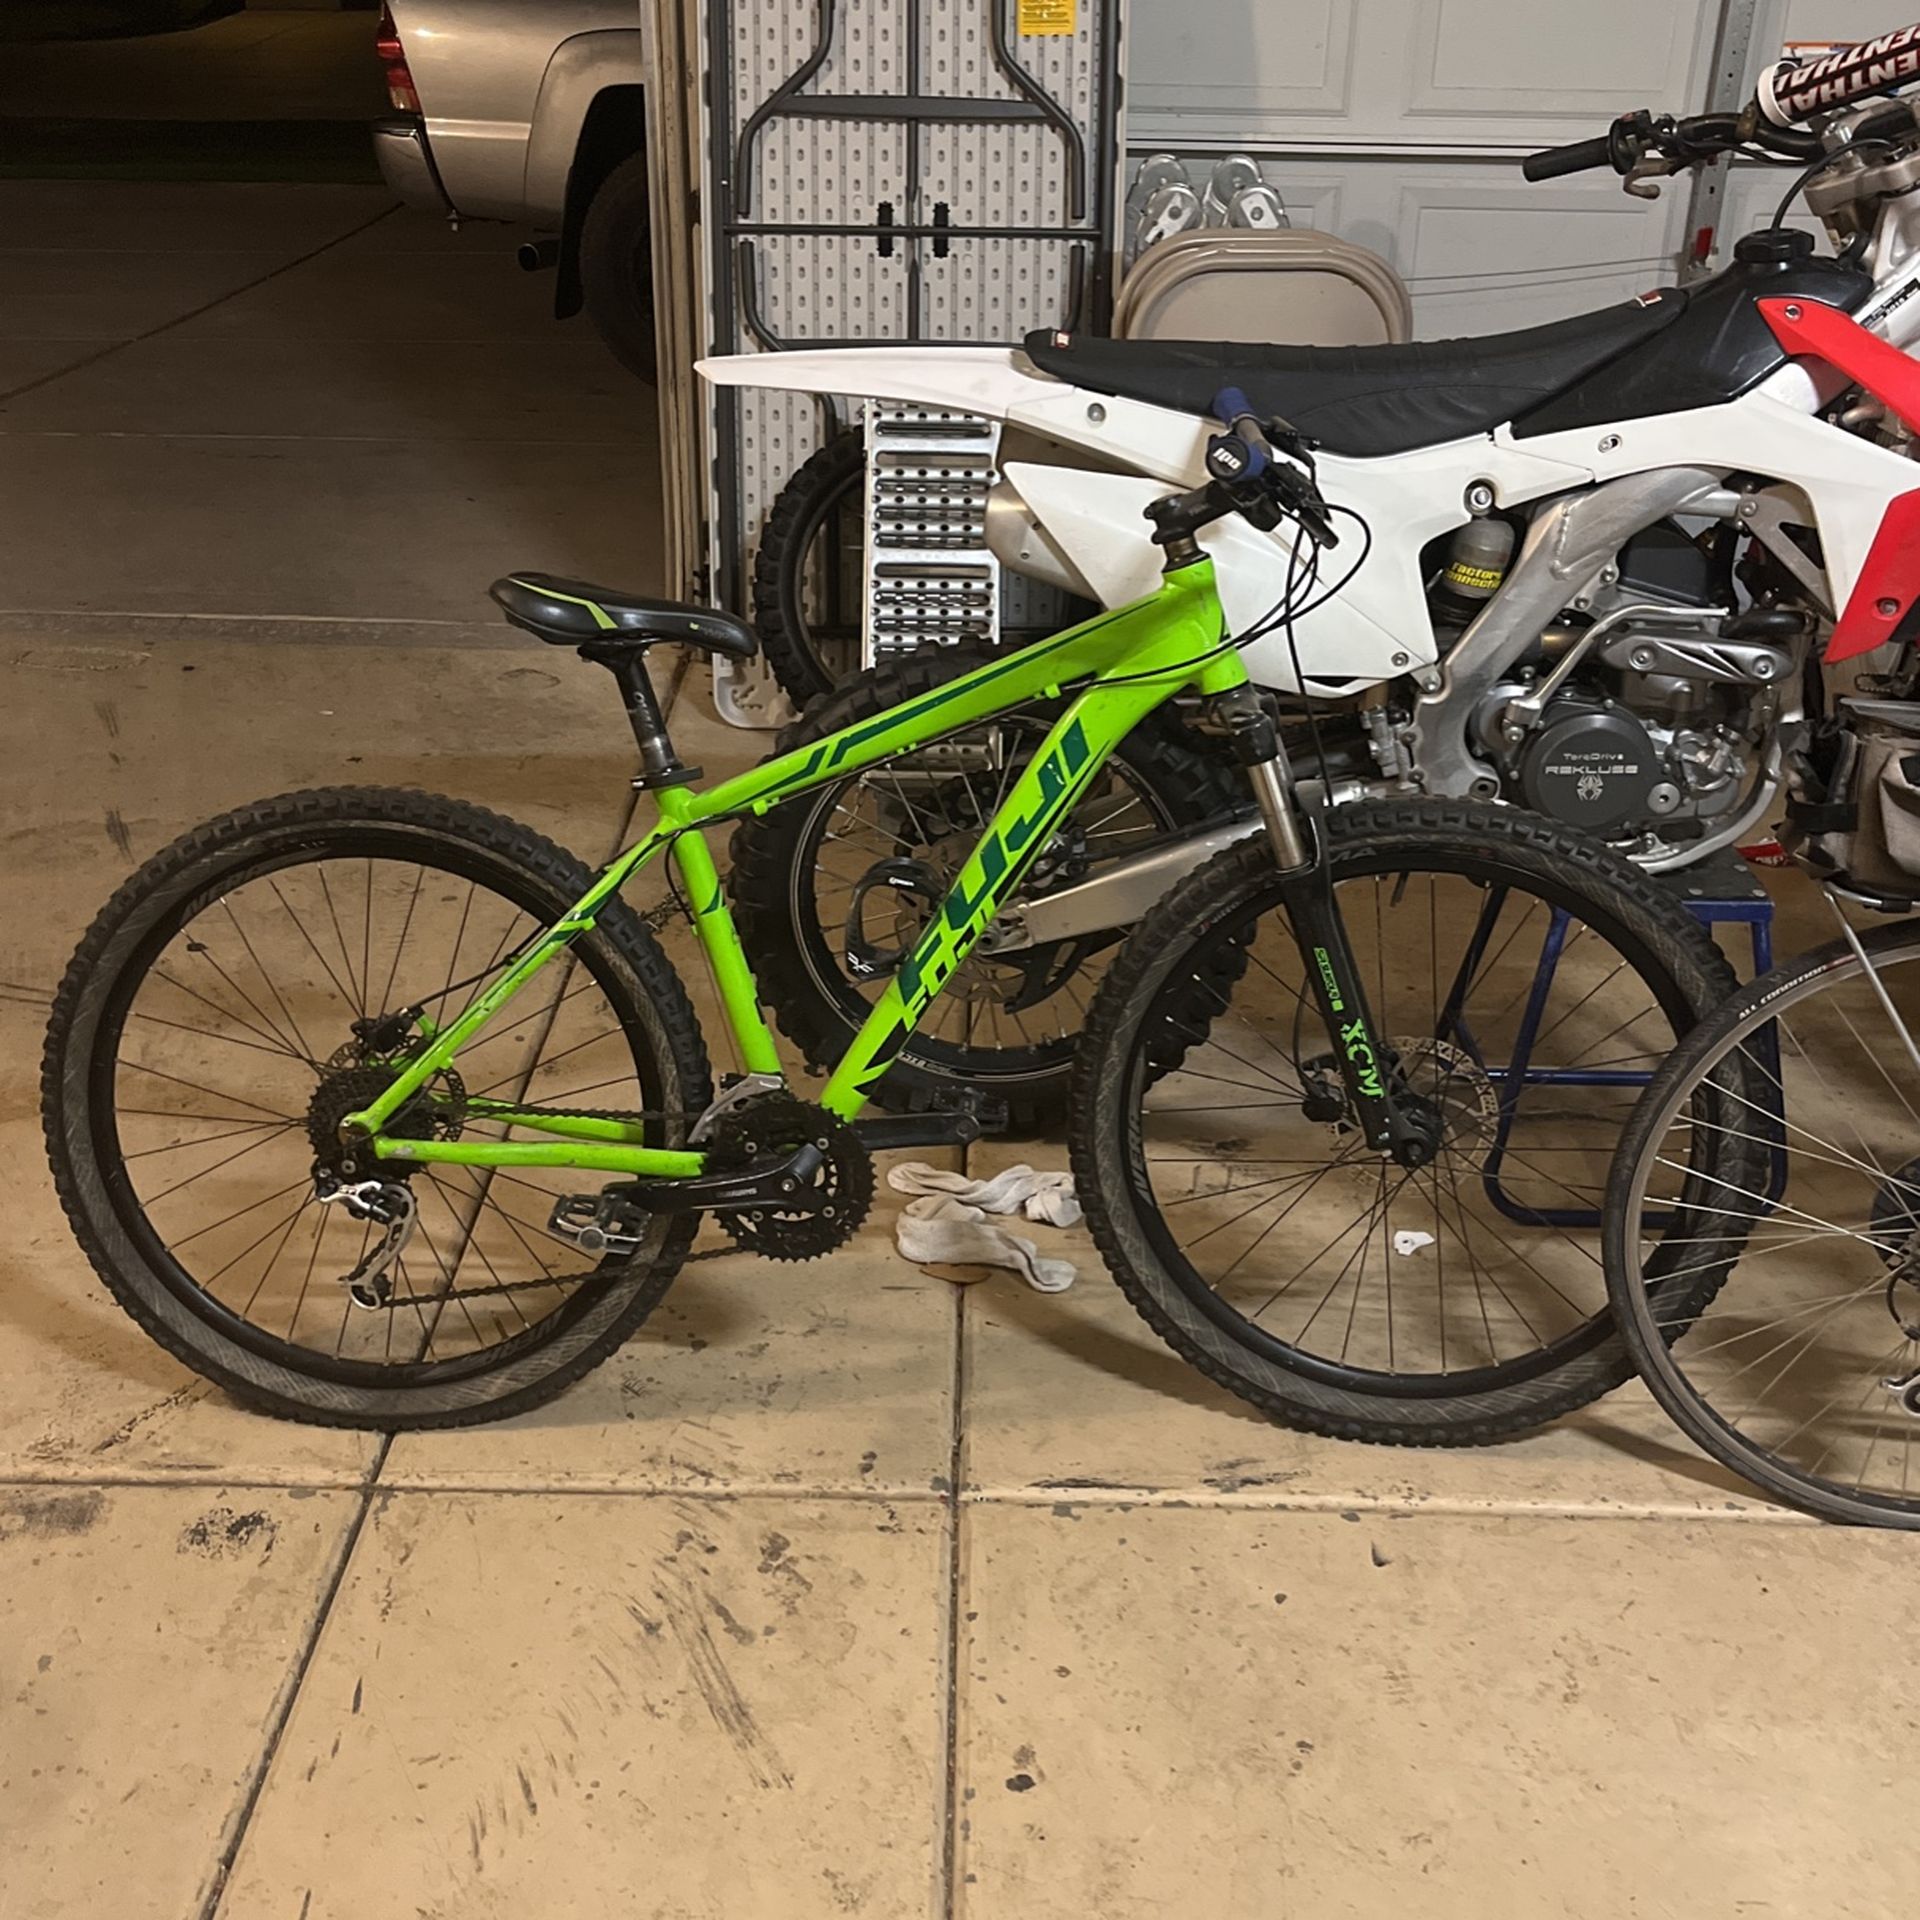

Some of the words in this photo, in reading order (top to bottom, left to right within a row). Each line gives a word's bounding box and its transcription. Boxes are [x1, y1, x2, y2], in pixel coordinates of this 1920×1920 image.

[1778, 50, 1920, 117] ENTHAL
[1545, 765, 1638, 775] REKLUSE
[897, 717, 1092, 1007] FUJI
[1339, 1018, 1385, 1099] XCM
